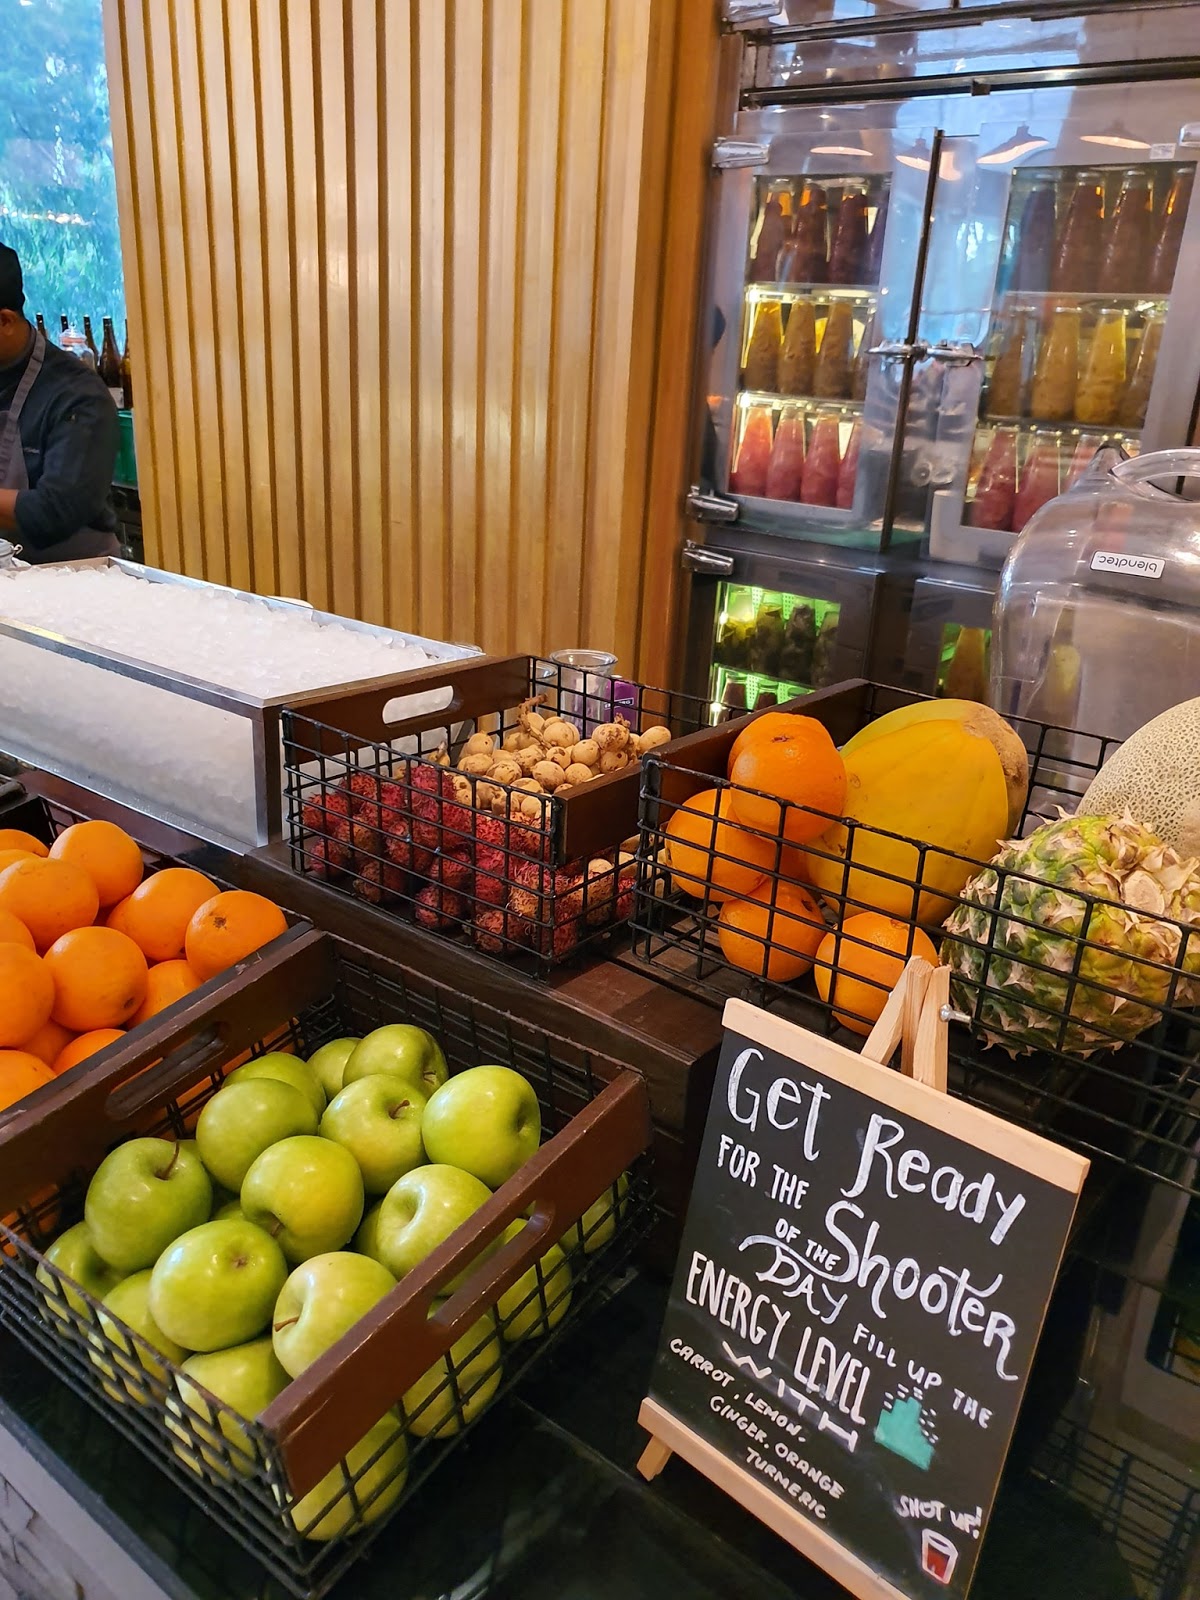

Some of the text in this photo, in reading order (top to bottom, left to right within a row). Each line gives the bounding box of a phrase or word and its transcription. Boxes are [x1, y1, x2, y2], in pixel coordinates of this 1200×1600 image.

[1098, 555, 1158, 573] blendtec
[717, 1134, 761, 1187] FOR
[771, 1164, 810, 1210] THE
[727, 1048, 1027, 1246] Get Ready
[775, 1218, 801, 1243] OF
[804, 1239, 841, 1271] THE
[685, 1251, 866, 1425] ENERGY LEVEL
[853, 1323, 993, 1429] FILL UP THE
[722, 1340, 859, 1453] WITH
[746, 1447, 827, 1519] TURMERIC
[775, 1442, 845, 1499] ORANGE
